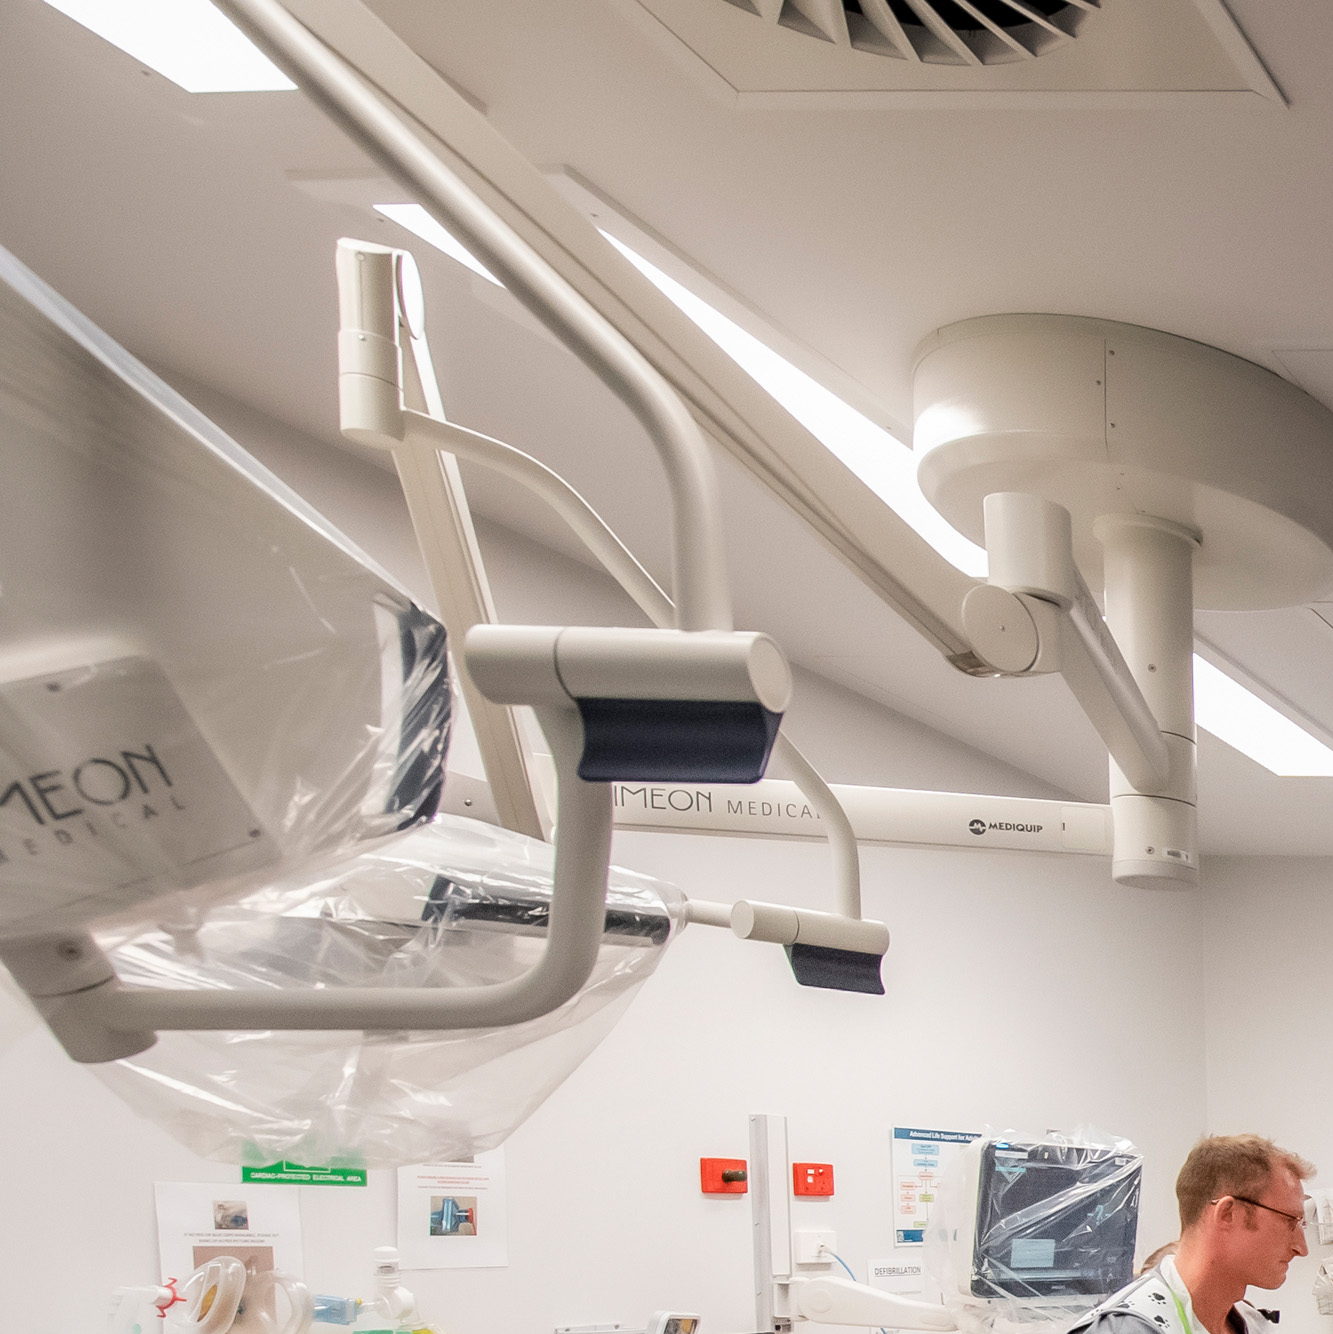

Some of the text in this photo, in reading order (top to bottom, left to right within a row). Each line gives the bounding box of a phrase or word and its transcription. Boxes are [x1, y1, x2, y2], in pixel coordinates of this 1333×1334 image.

[0, 744, 172, 826] MEON
[613, 784, 712, 813] IMEON
[0, 795, 186, 865] EDICAL
[988, 822, 1043, 833] MEDIQUIP
[874, 1266, 921, 1276] DEFIBRILLATION
